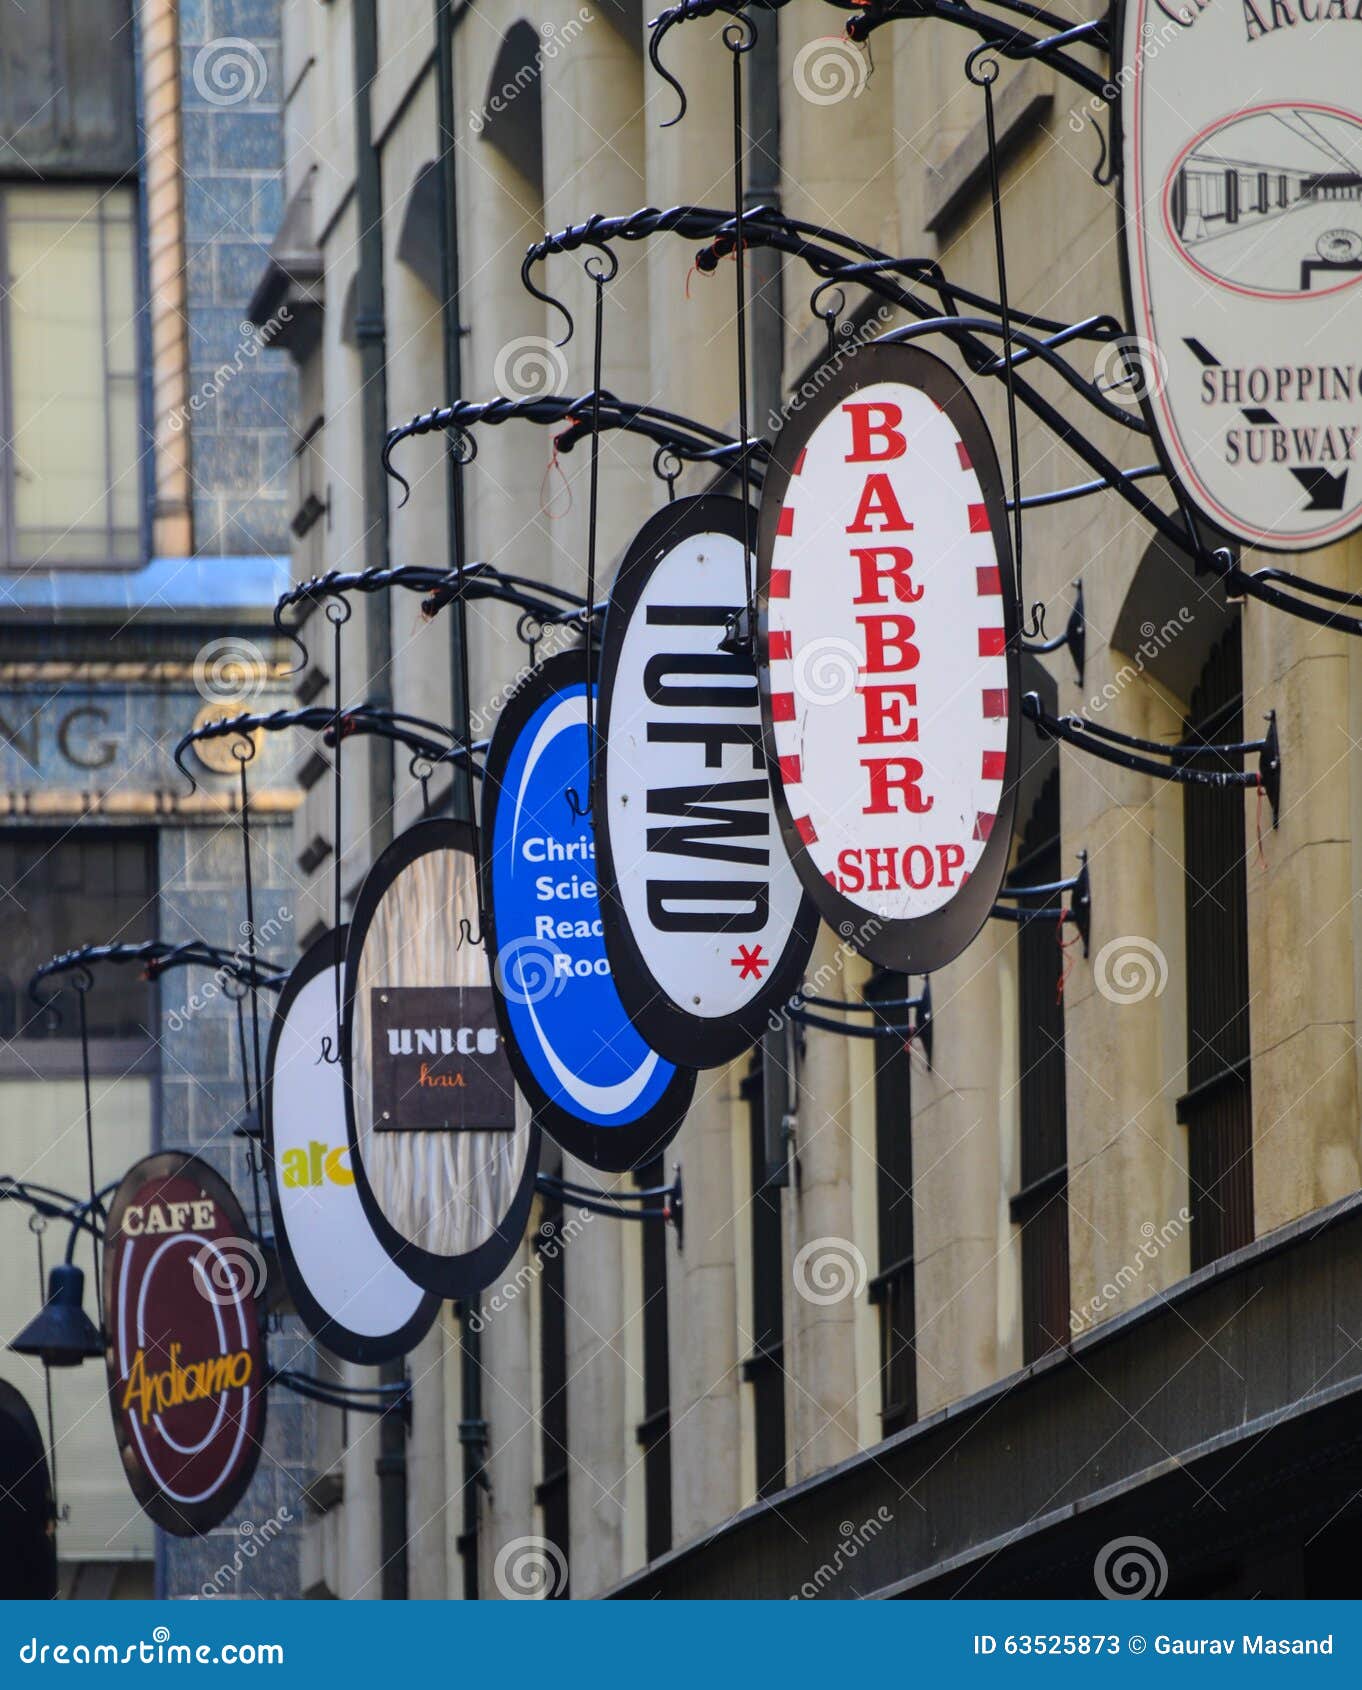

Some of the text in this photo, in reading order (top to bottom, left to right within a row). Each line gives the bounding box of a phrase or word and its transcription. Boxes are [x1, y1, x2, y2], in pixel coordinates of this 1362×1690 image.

[1201, 366, 1362, 405] SHOPPIN
[1226, 426, 1357, 465] SUBWAY
[842, 401, 934, 815] BARBER
[837, 842, 966, 893] SHOP
[122, 1342, 252, 1425] Andiamo
